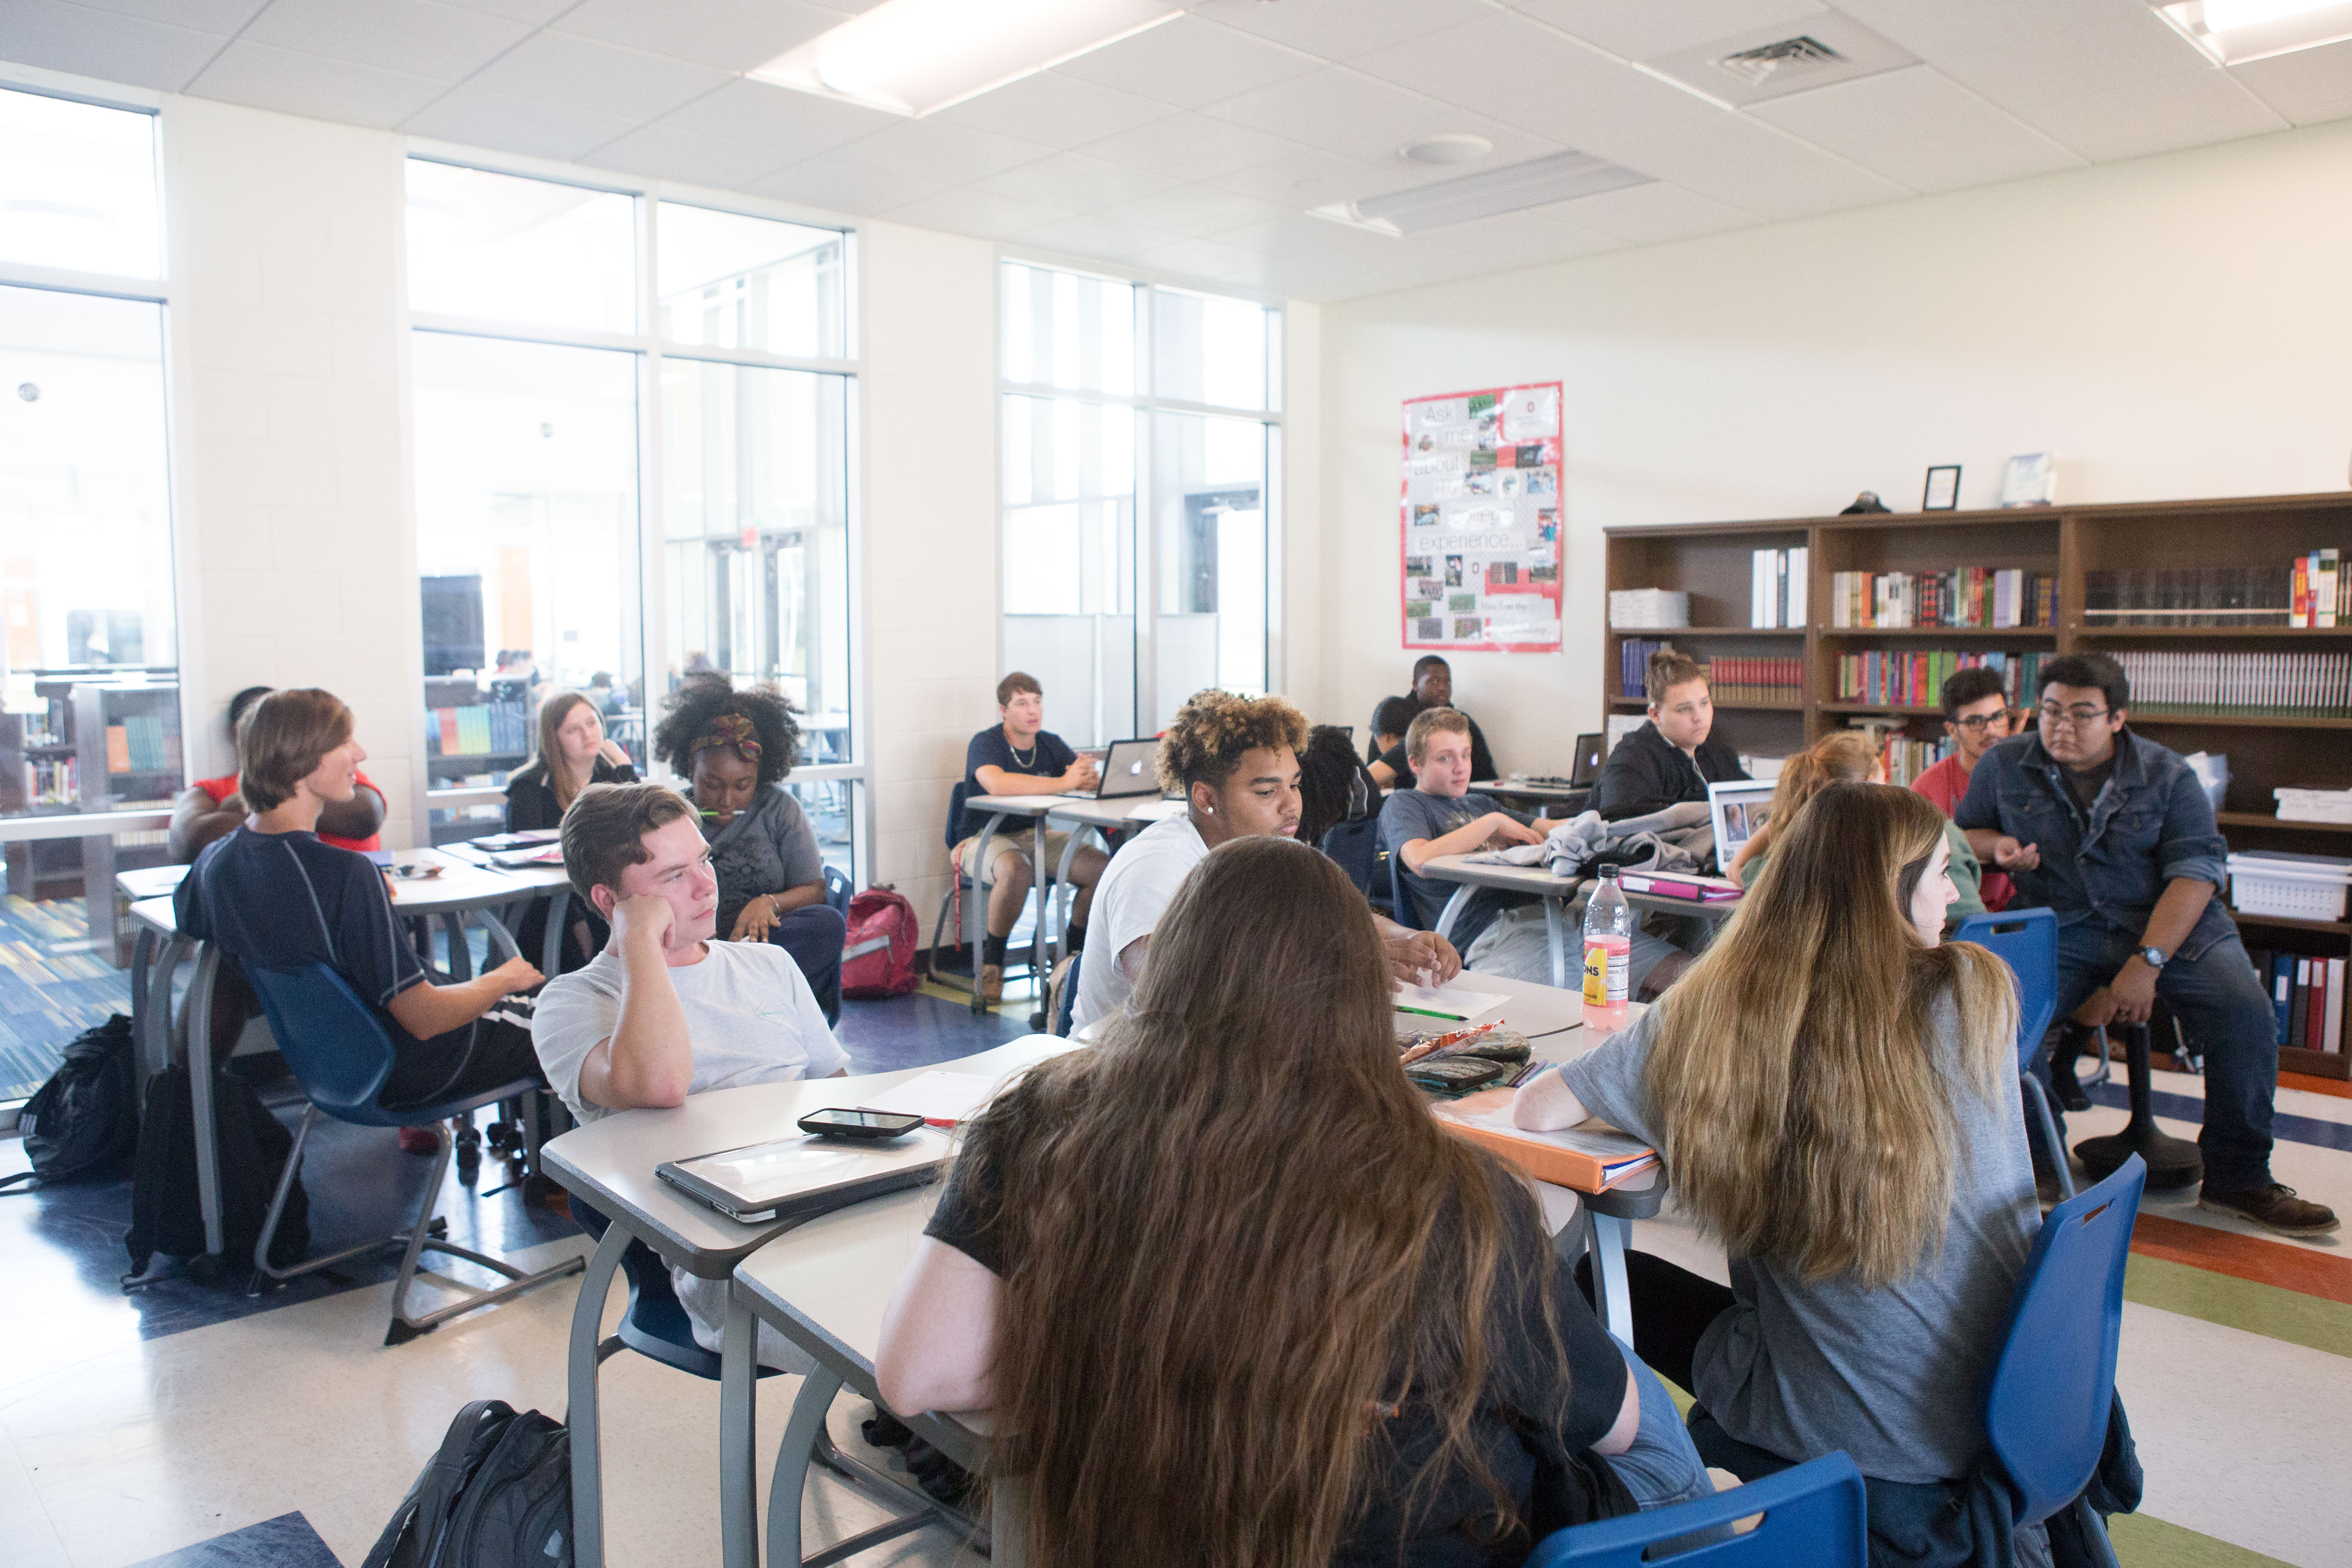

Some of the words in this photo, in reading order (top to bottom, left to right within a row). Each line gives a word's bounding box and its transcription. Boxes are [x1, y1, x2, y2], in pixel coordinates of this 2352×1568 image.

[1426, 404, 1454, 422] Ask
[1446, 429, 1470, 443] me
[1415, 456, 1458, 475] about
[1516, 601, 1527, 613] thy
